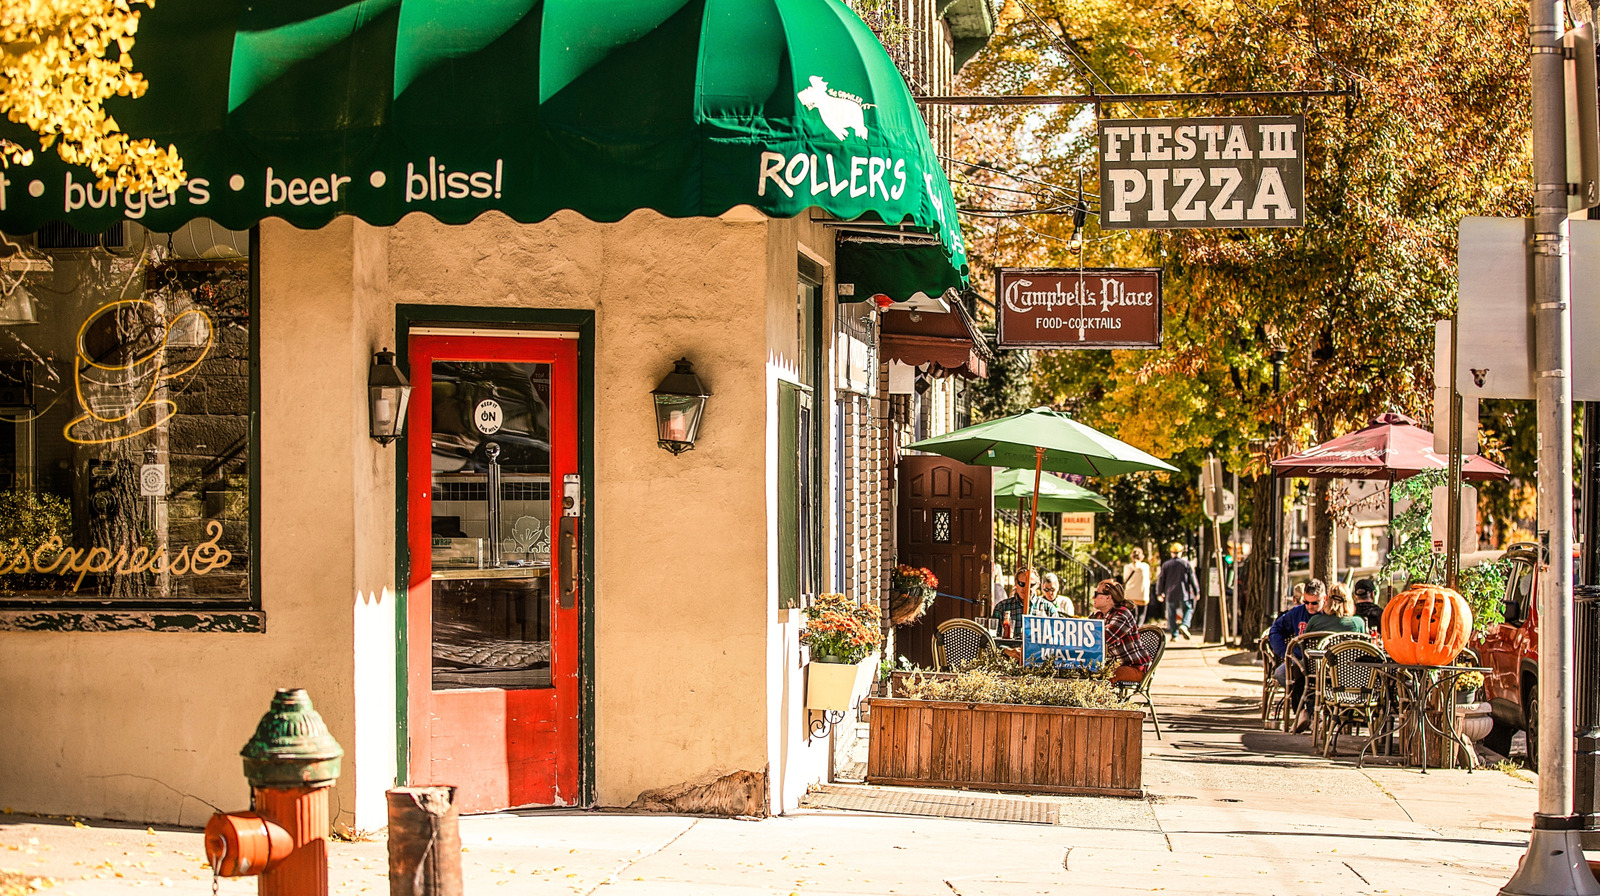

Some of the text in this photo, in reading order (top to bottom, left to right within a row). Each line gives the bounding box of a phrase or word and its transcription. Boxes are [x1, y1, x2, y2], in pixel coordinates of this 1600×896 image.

[1104, 124, 1297, 162] FIESTA III
[266, 166, 351, 208] beer
[406, 156, 503, 202] bliss!
[757, 151, 907, 202] ROLLER'S
[1108, 167, 1297, 222] PIZZA
[1005, 278, 1154, 313] Campbell's Place
[480, 401, 492, 409] KEEP
[481, 411, 496, 421] ON
[479, 424, 488, 432] THE
[1030, 618, 1096, 648] HARRIS
[1041, 647, 1086, 663] WALZ
